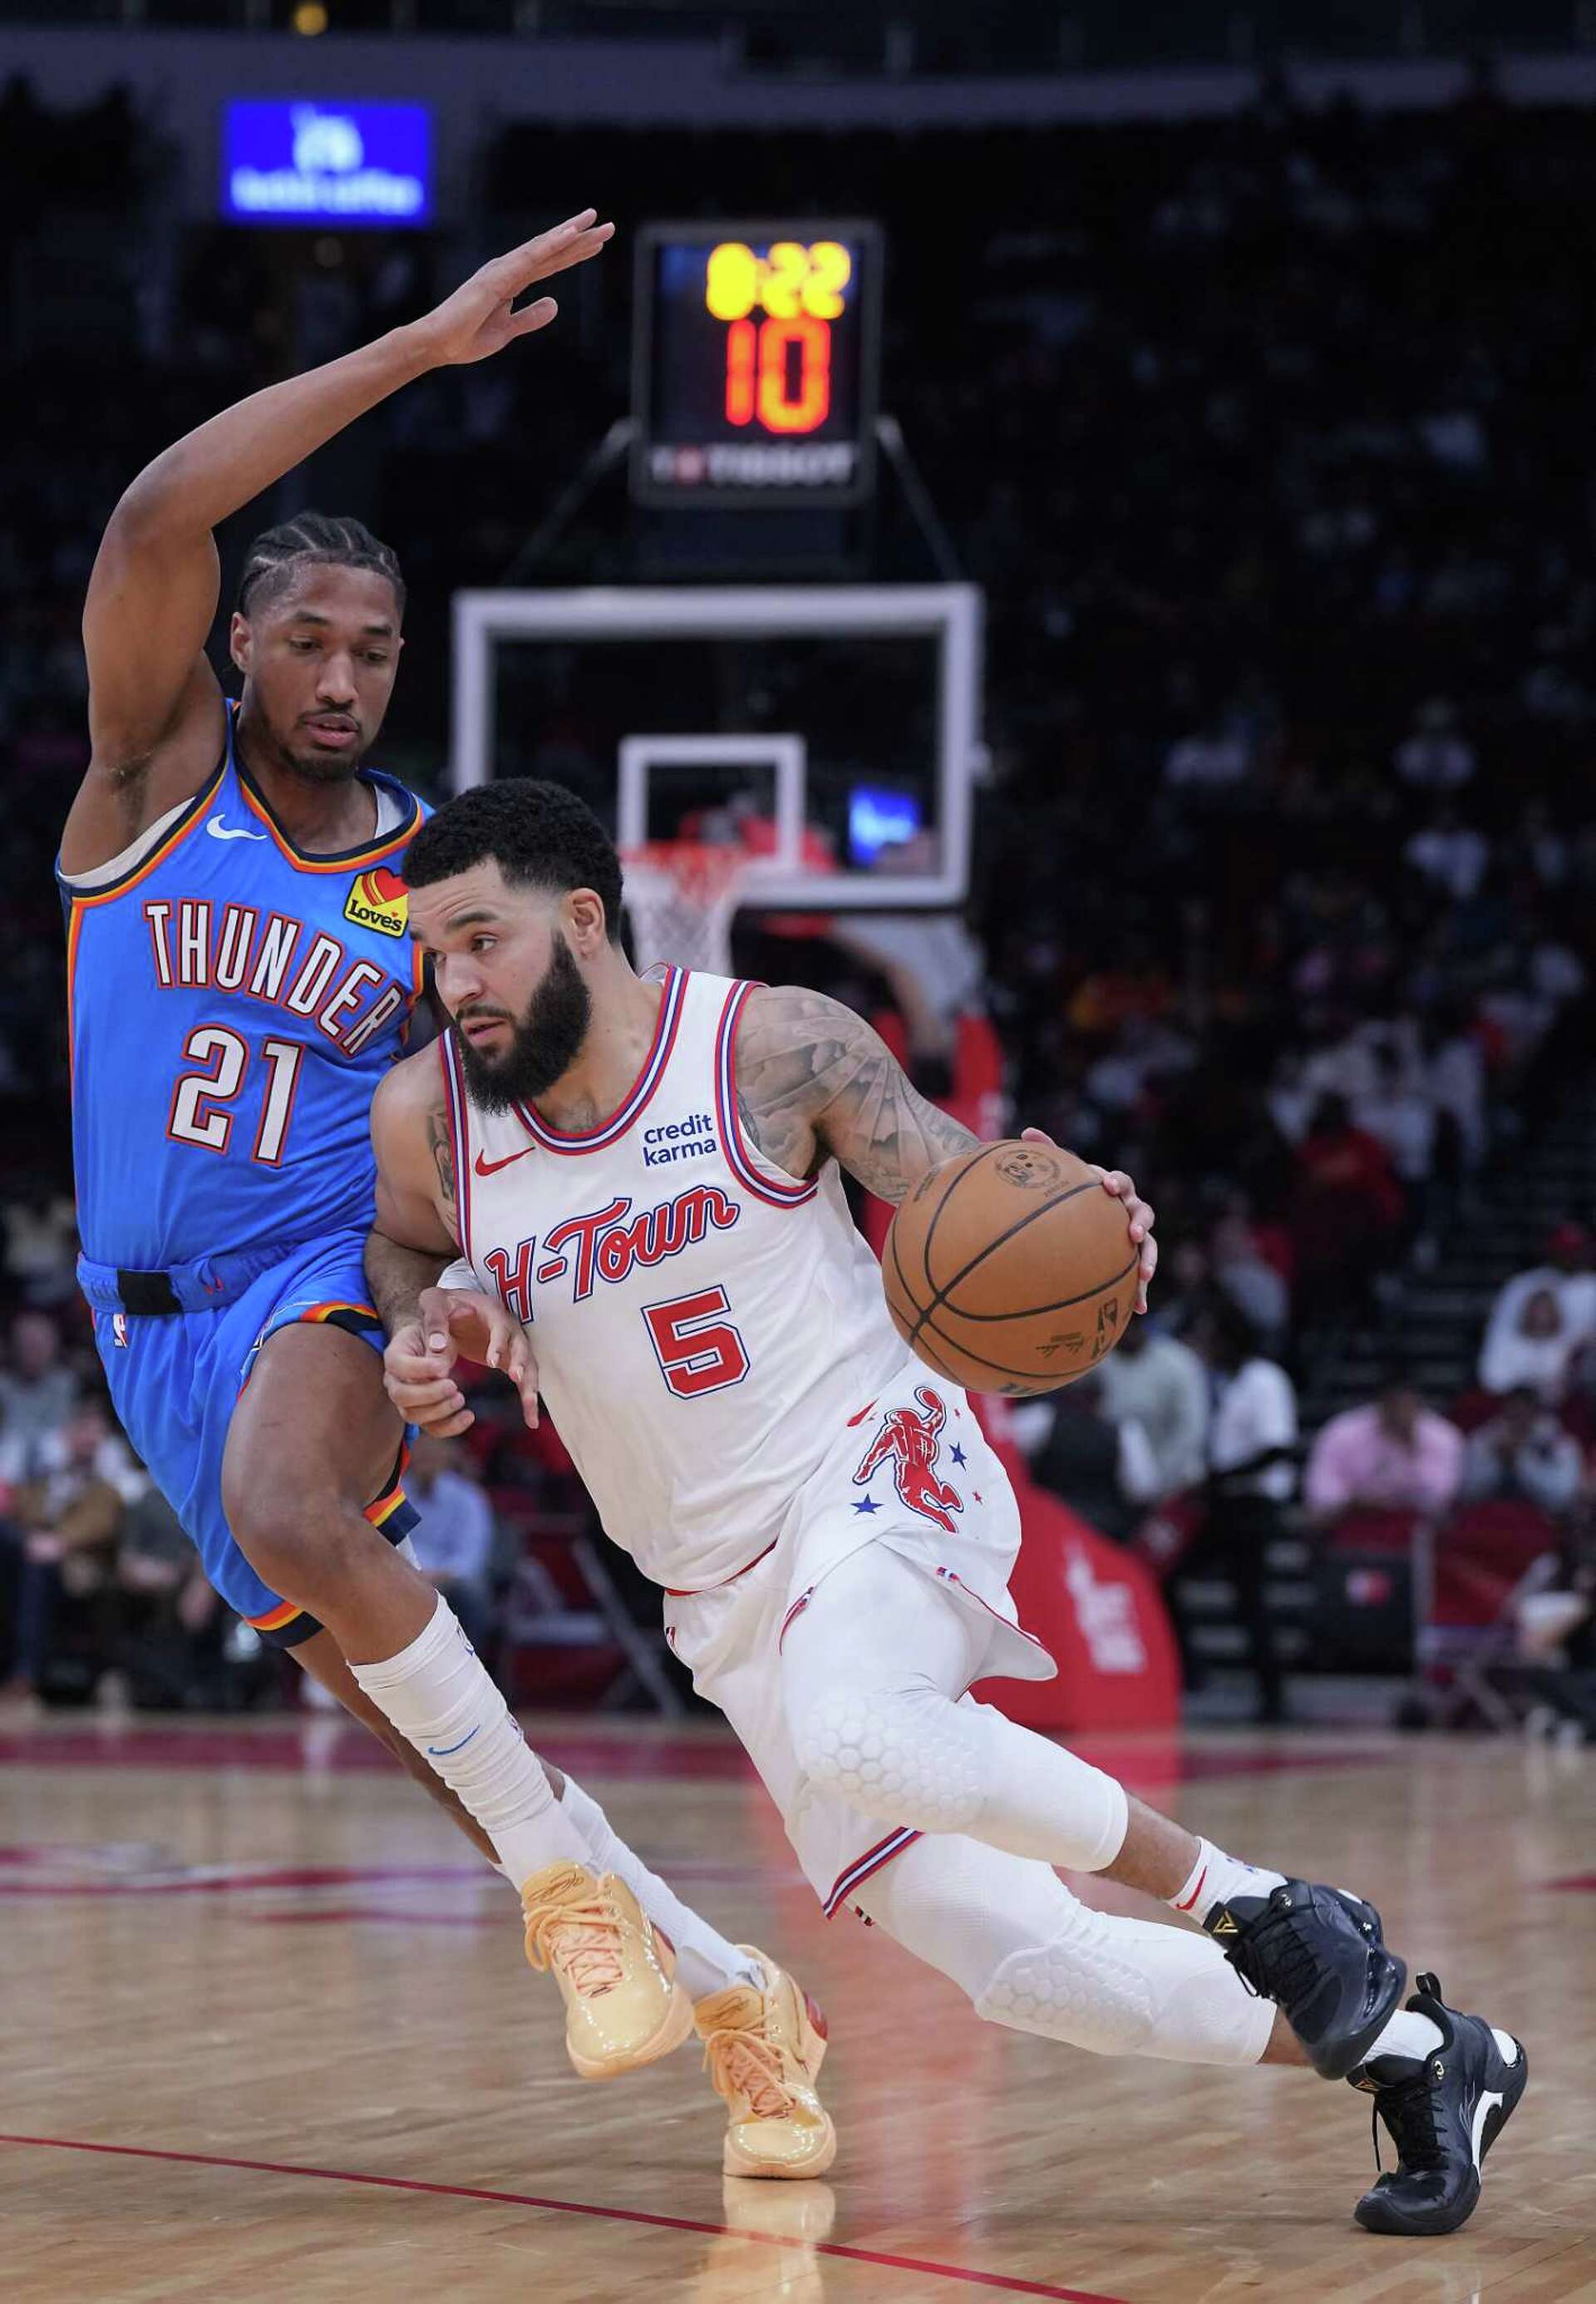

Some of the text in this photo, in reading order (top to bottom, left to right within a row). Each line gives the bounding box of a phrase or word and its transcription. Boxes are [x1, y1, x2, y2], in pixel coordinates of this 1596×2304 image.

[707, 242, 850, 320] 8:22
[726, 318, 830, 433] 10
[142, 900, 411, 1058] THUNDER
[165, 1023, 306, 1167] 21
[643, 1138, 717, 1167] karma
[644, 1114, 713, 1144] credit
[484, 1184, 741, 1325] H-Town
[641, 1285, 750, 1400] 5
